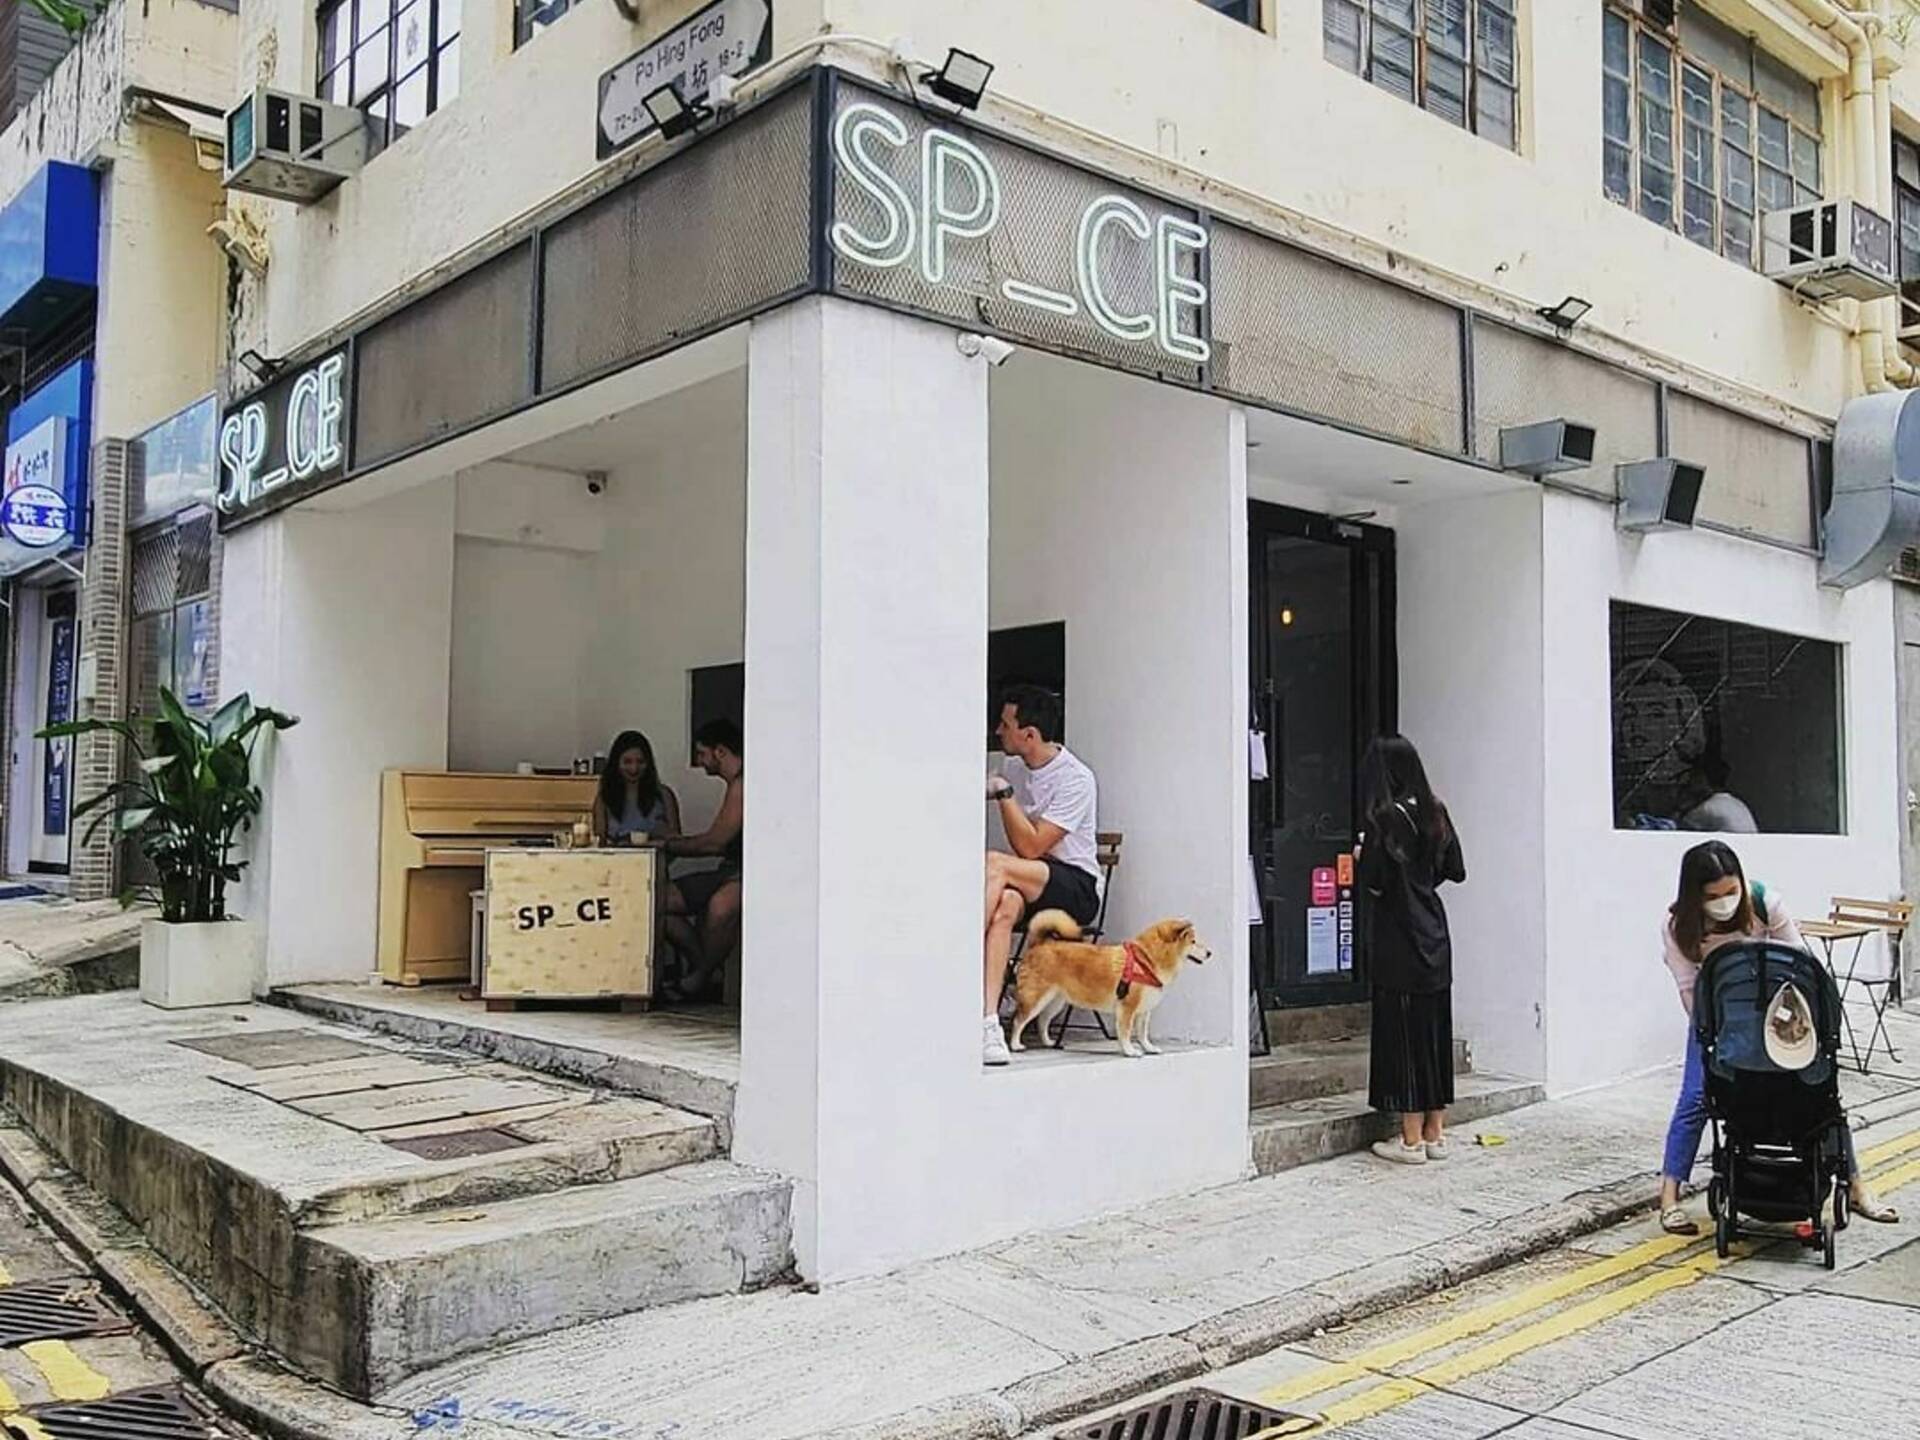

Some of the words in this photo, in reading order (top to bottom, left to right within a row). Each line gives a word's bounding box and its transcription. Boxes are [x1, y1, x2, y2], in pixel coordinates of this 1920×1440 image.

[635, 61, 654, 85] Po
[657, 41, 686, 71] Hing
[689, 13, 725, 49] Fong
[831, 102, 1209, 361] SP_CE
[218, 352, 346, 514] SP_CE
[518, 897, 612, 930] SP_CE
